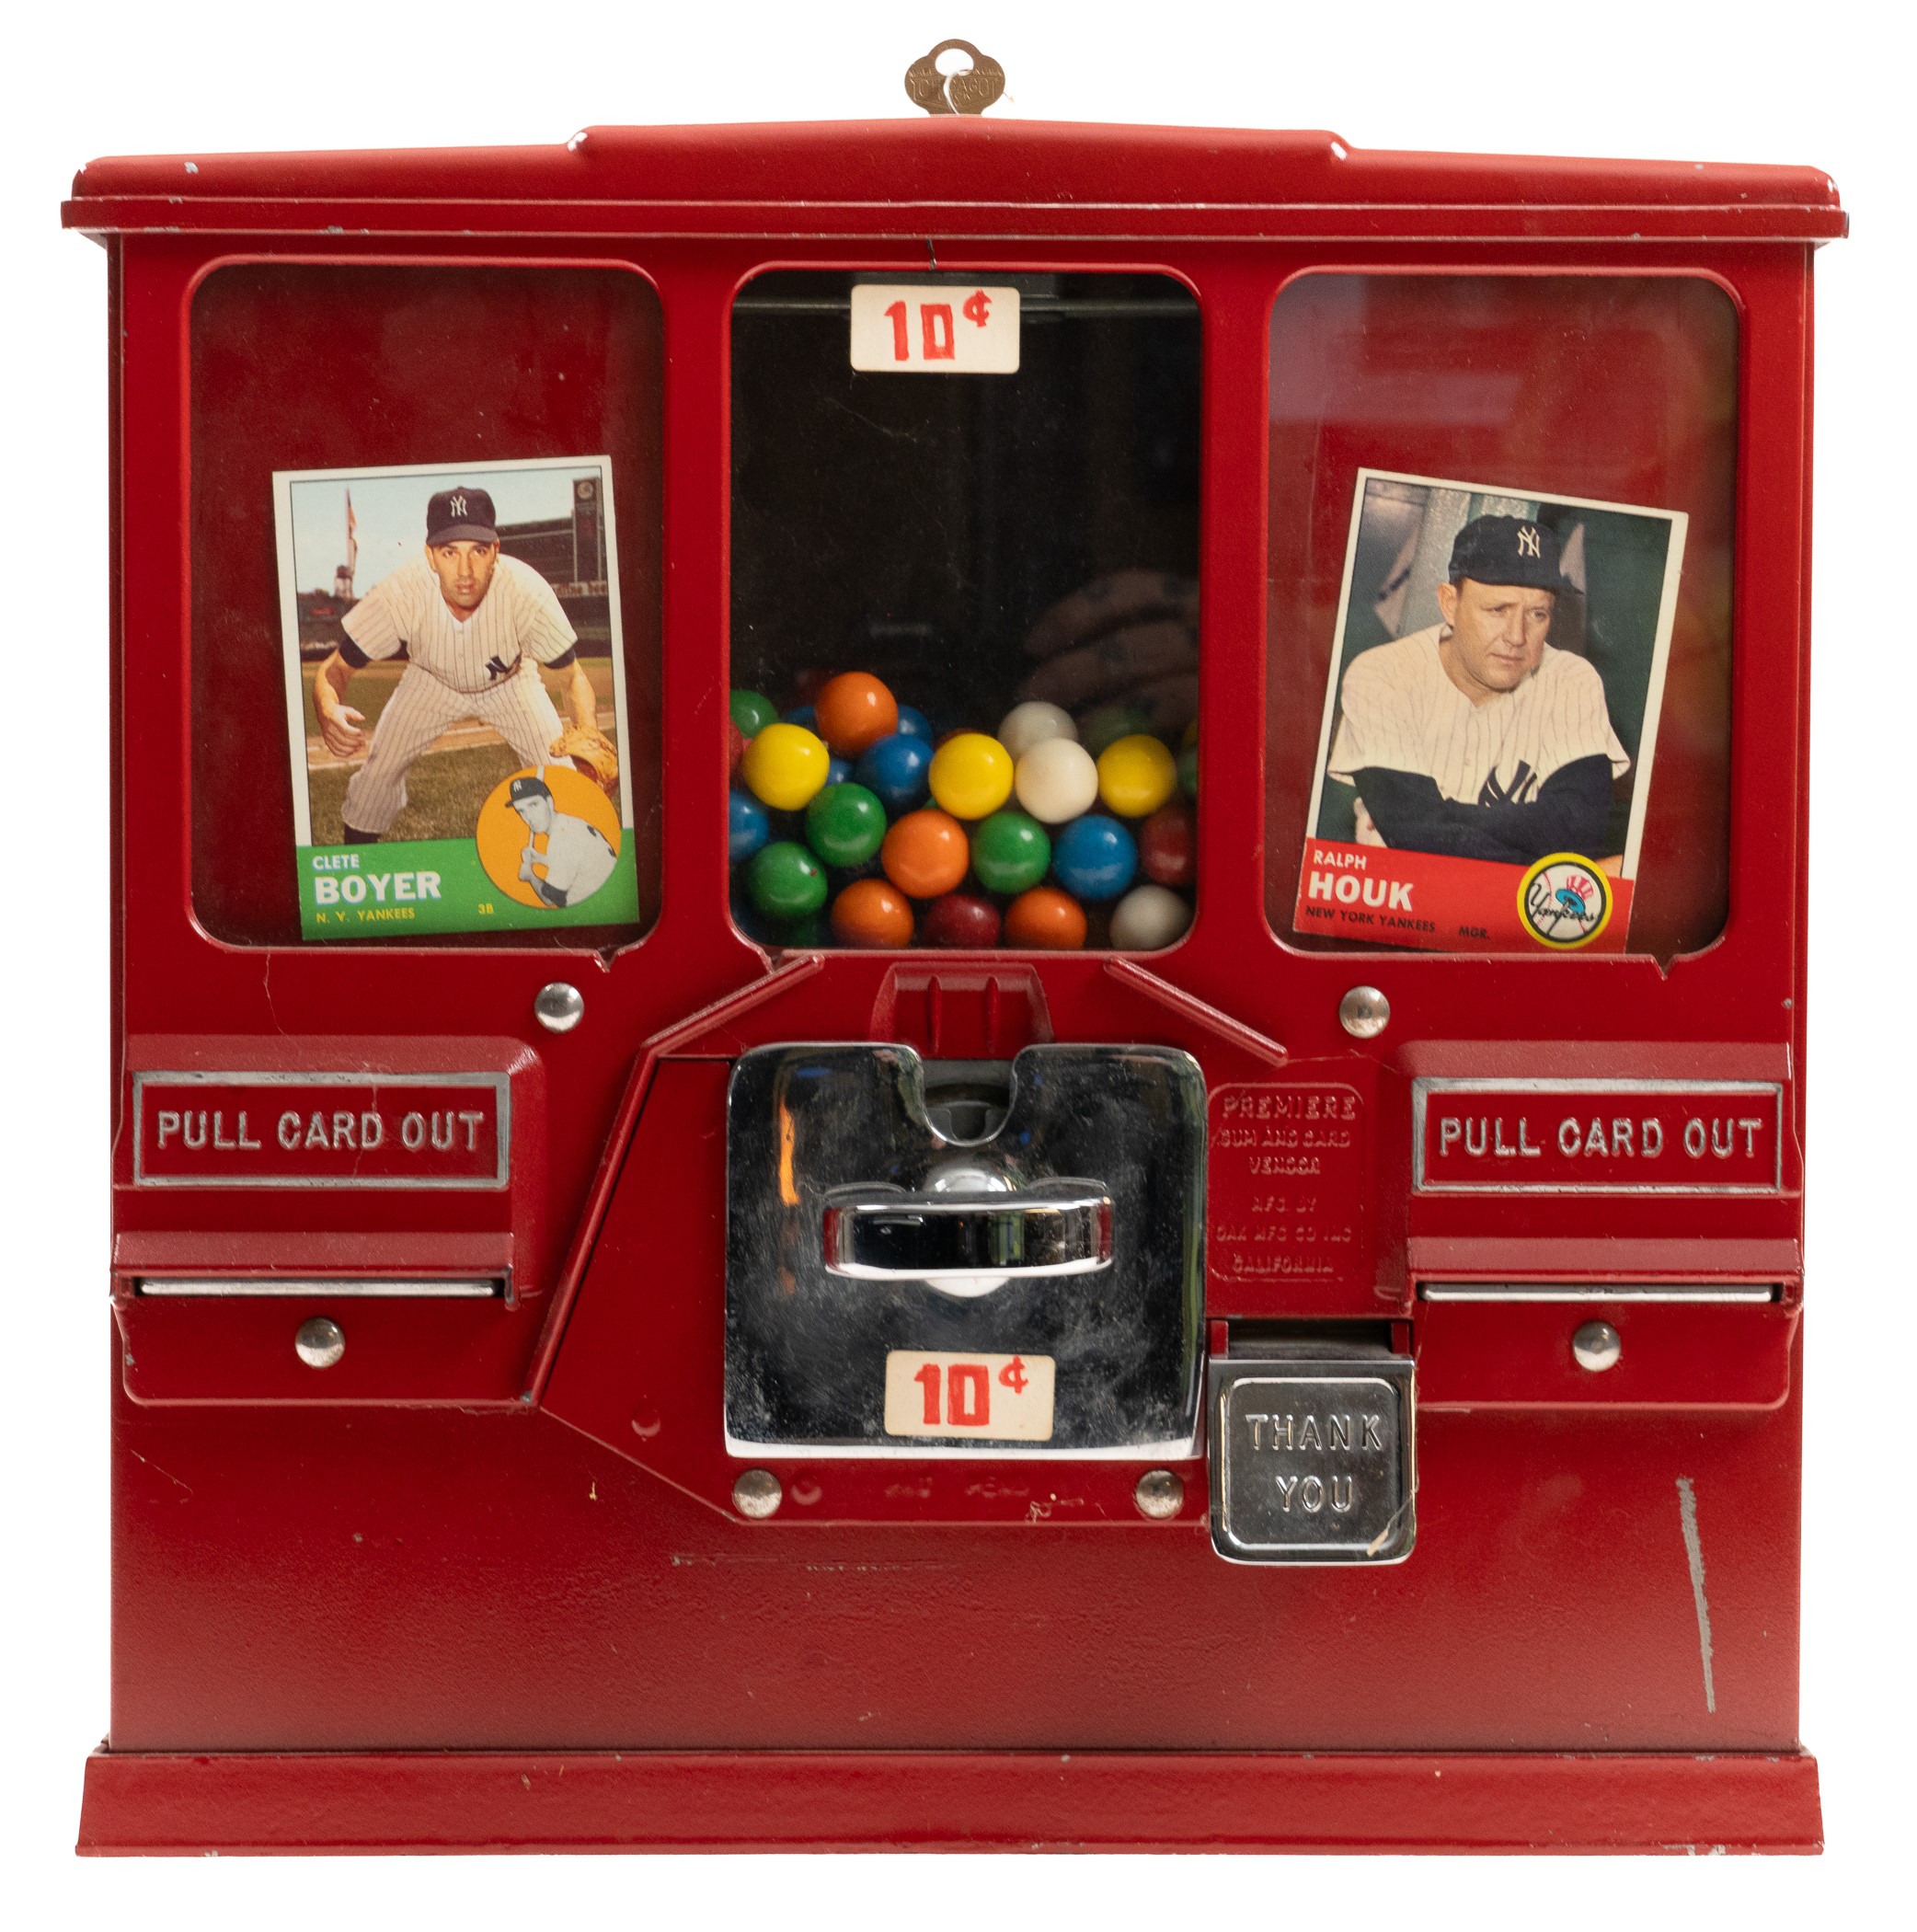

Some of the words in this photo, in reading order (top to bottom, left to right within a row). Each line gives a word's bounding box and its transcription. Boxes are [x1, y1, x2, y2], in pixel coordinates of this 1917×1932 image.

[884, 289, 992, 361] 10¢
[312, 853, 360, 870] CLETE
[1313, 849, 1367, 870] RALPH
[315, 870, 442, 905] BOYER
[1308, 870, 1414, 912] HOUK
[357, 907, 416, 922] YANKEES
[1305, 905, 1336, 919] NEW
[1339, 910, 1374, 925] YORK
[1379, 914, 1436, 932] YANKEES
[1458, 926, 1489, 939] MGR.
[1222, 1095, 1356, 1120] PREMIERE
[157, 1110, 261, 1150] PULL
[278, 1110, 384, 1150] CARD
[401, 1110, 485, 1152] OUT
[1439, 1116, 1542, 1157] PULL
[1557, 1116, 1664, 1157] CARD
[1682, 1117, 1763, 1158] OUT
[914, 1355, 1028, 1426] 10¢
[1245, 1414, 1382, 1451] THANK
[1275, 1475, 1353, 1513] YOU
